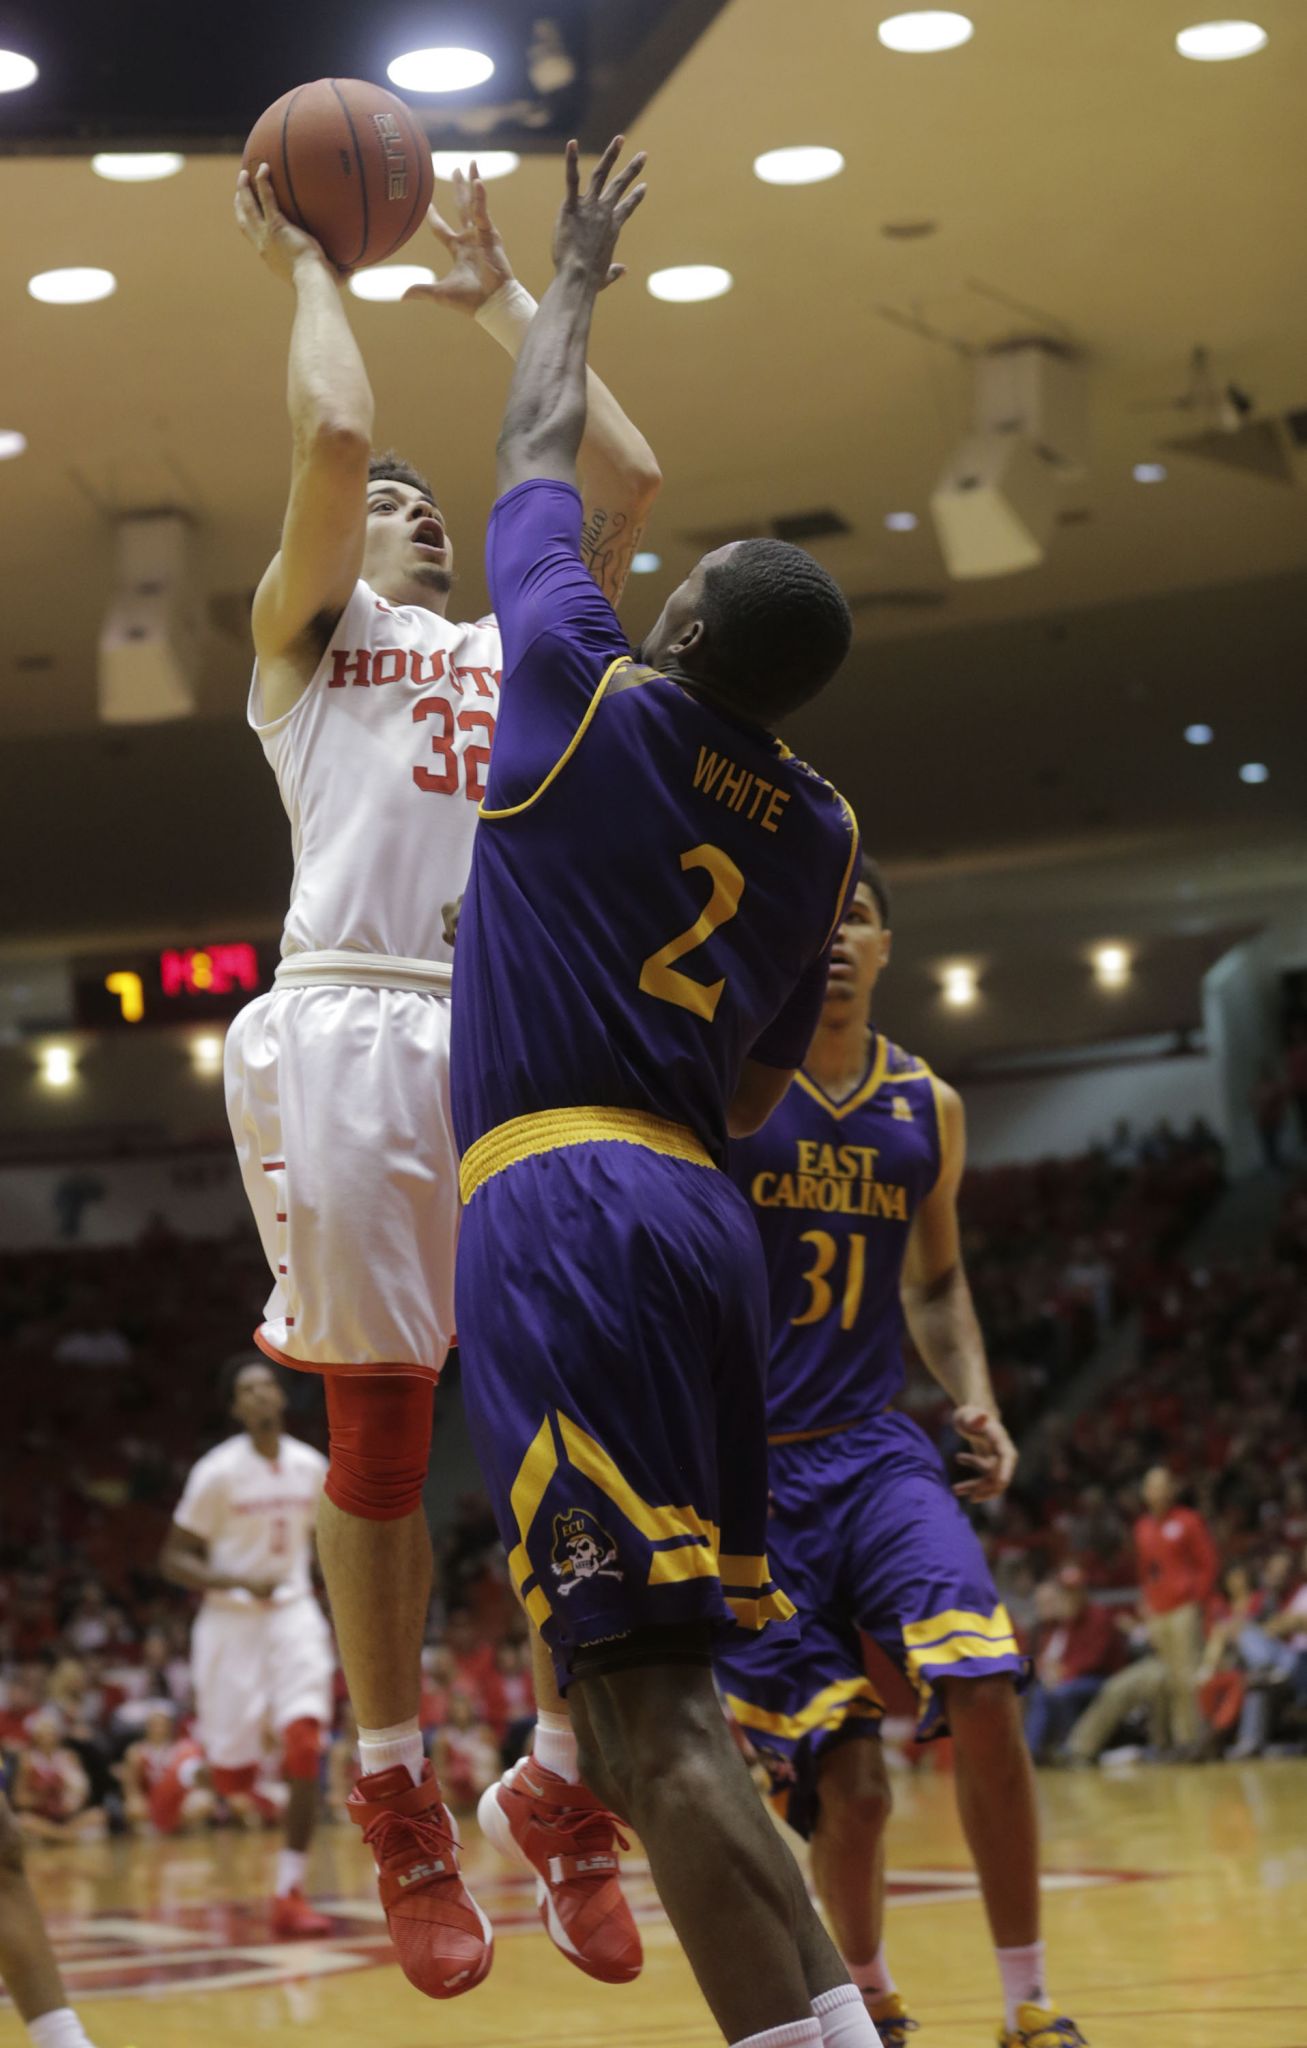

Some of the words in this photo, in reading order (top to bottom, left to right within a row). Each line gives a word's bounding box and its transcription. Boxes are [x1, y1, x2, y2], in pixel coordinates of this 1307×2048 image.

[328, 648, 503, 698] HOUST
[412, 696, 497, 801] 32
[692, 745, 791, 833] WHITE
[638, 843, 745, 1023] 2
[796, 1139, 879, 1181] EAST
[751, 1171, 908, 1221] CAROLINA
[790, 1229, 867, 1331] 31
[562, 1518, 585, 1538] ECU
